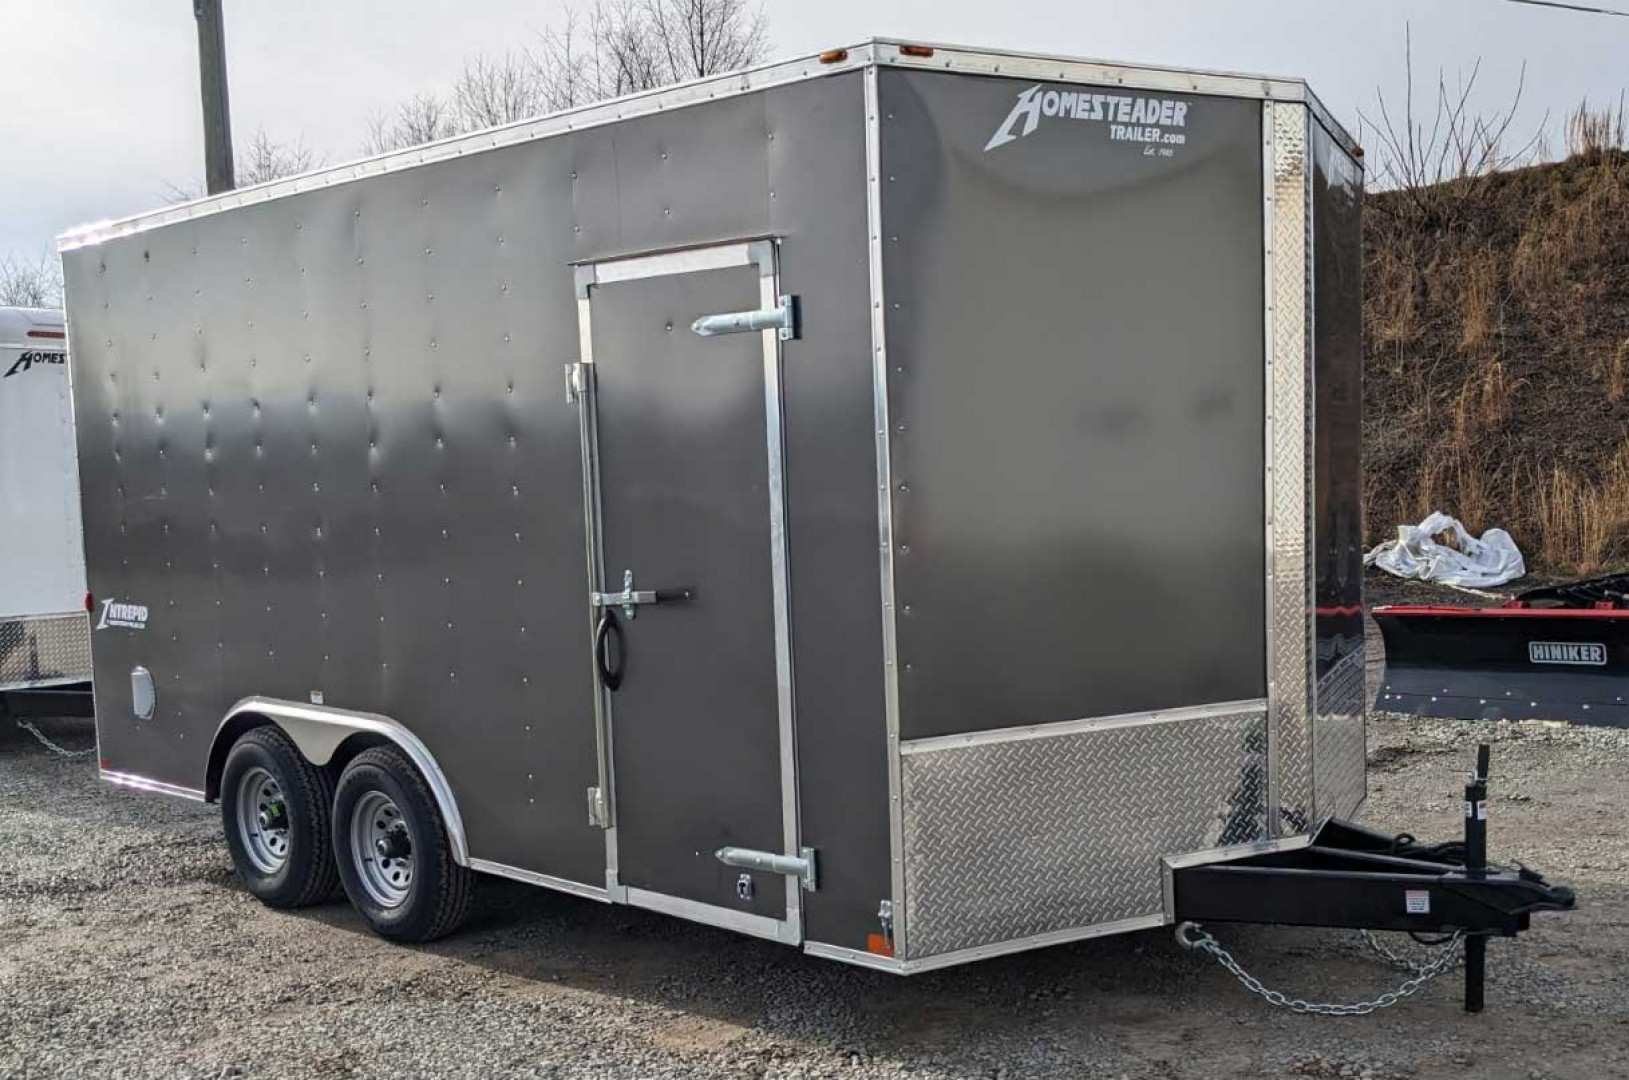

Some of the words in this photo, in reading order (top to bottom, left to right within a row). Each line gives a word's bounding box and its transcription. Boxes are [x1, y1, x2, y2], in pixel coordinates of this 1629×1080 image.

[984, 83, 1187, 151] HOMESTEADER
[1110, 125, 1186, 144] TRAILER.com
[96, 598, 148, 629] INTREPID
[1533, 645, 1602, 661] HINIKER
